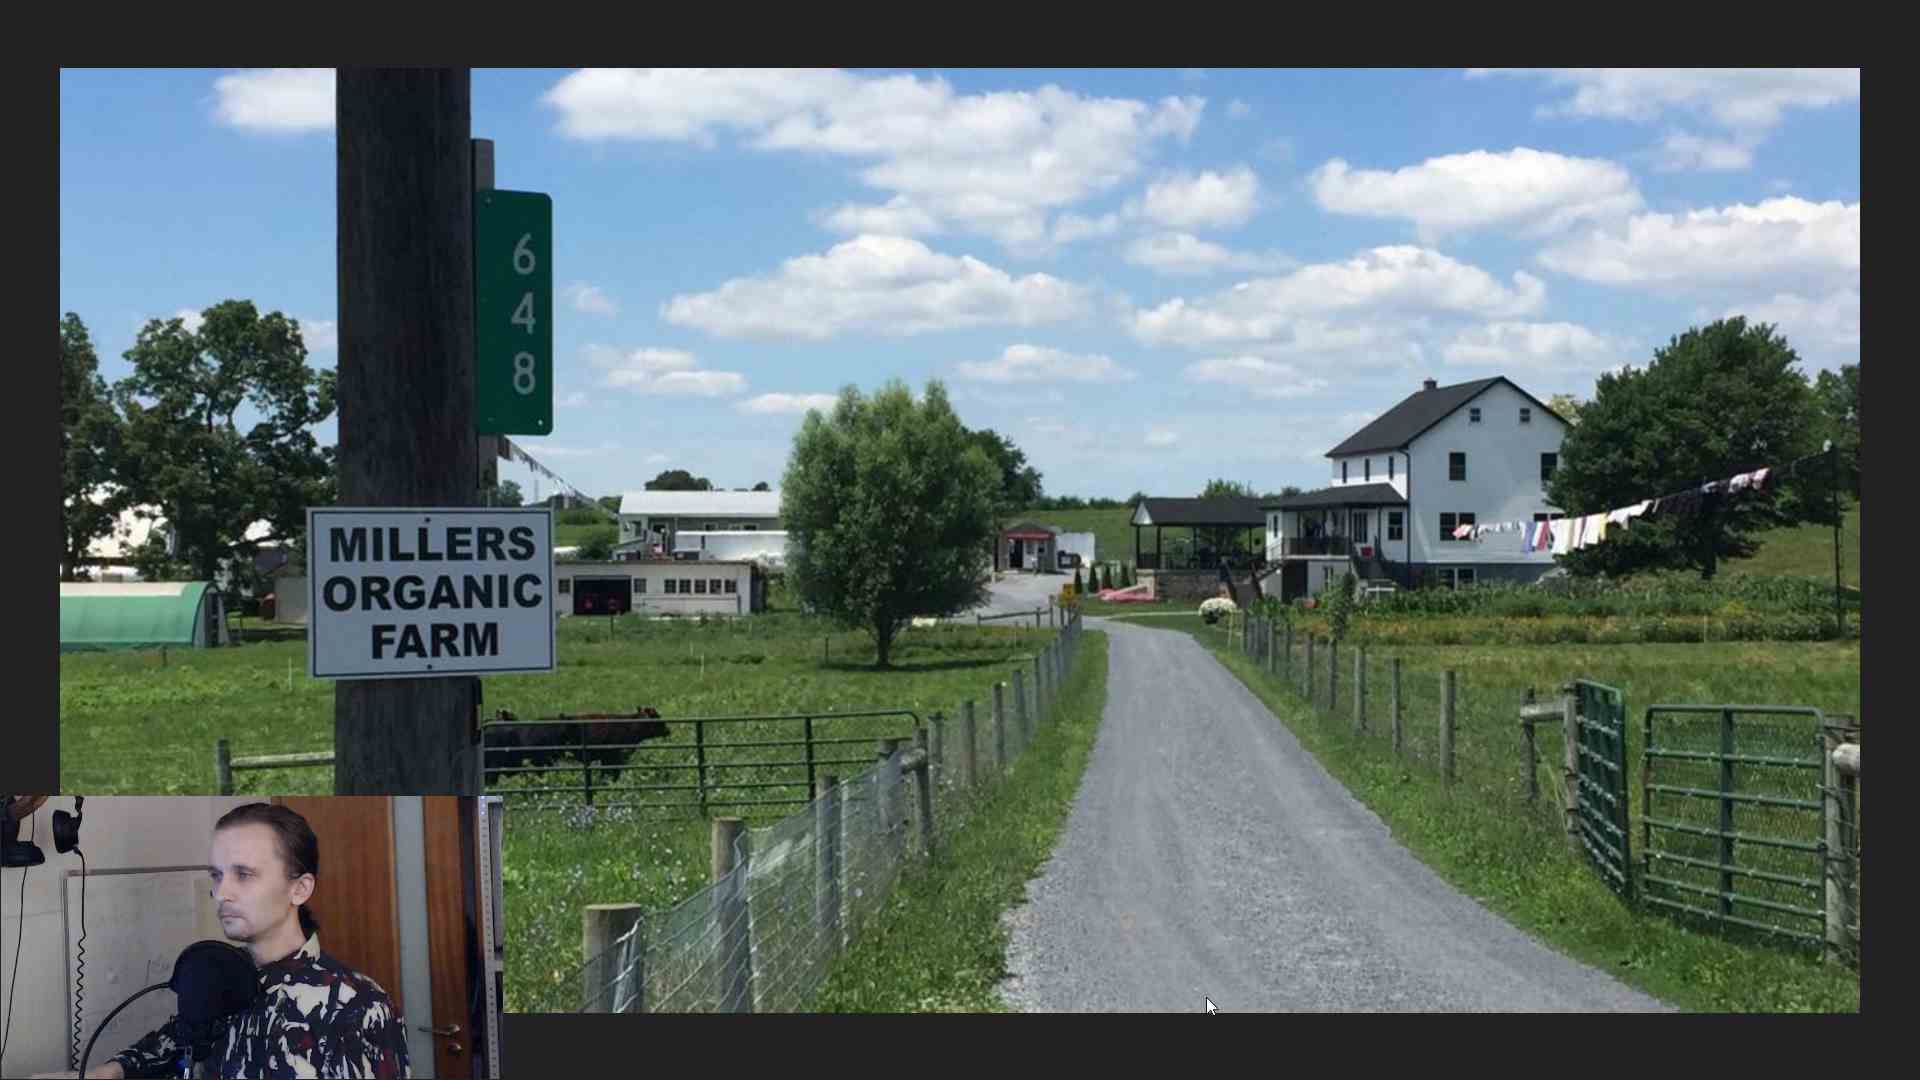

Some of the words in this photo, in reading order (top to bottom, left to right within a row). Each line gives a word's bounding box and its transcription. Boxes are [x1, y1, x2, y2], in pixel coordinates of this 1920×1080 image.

[511, 232, 537, 394] 648
[329, 526, 536, 562] MILLERS
[322, 573, 543, 611] ORGANIC
[371, 622, 499, 659] FARM
